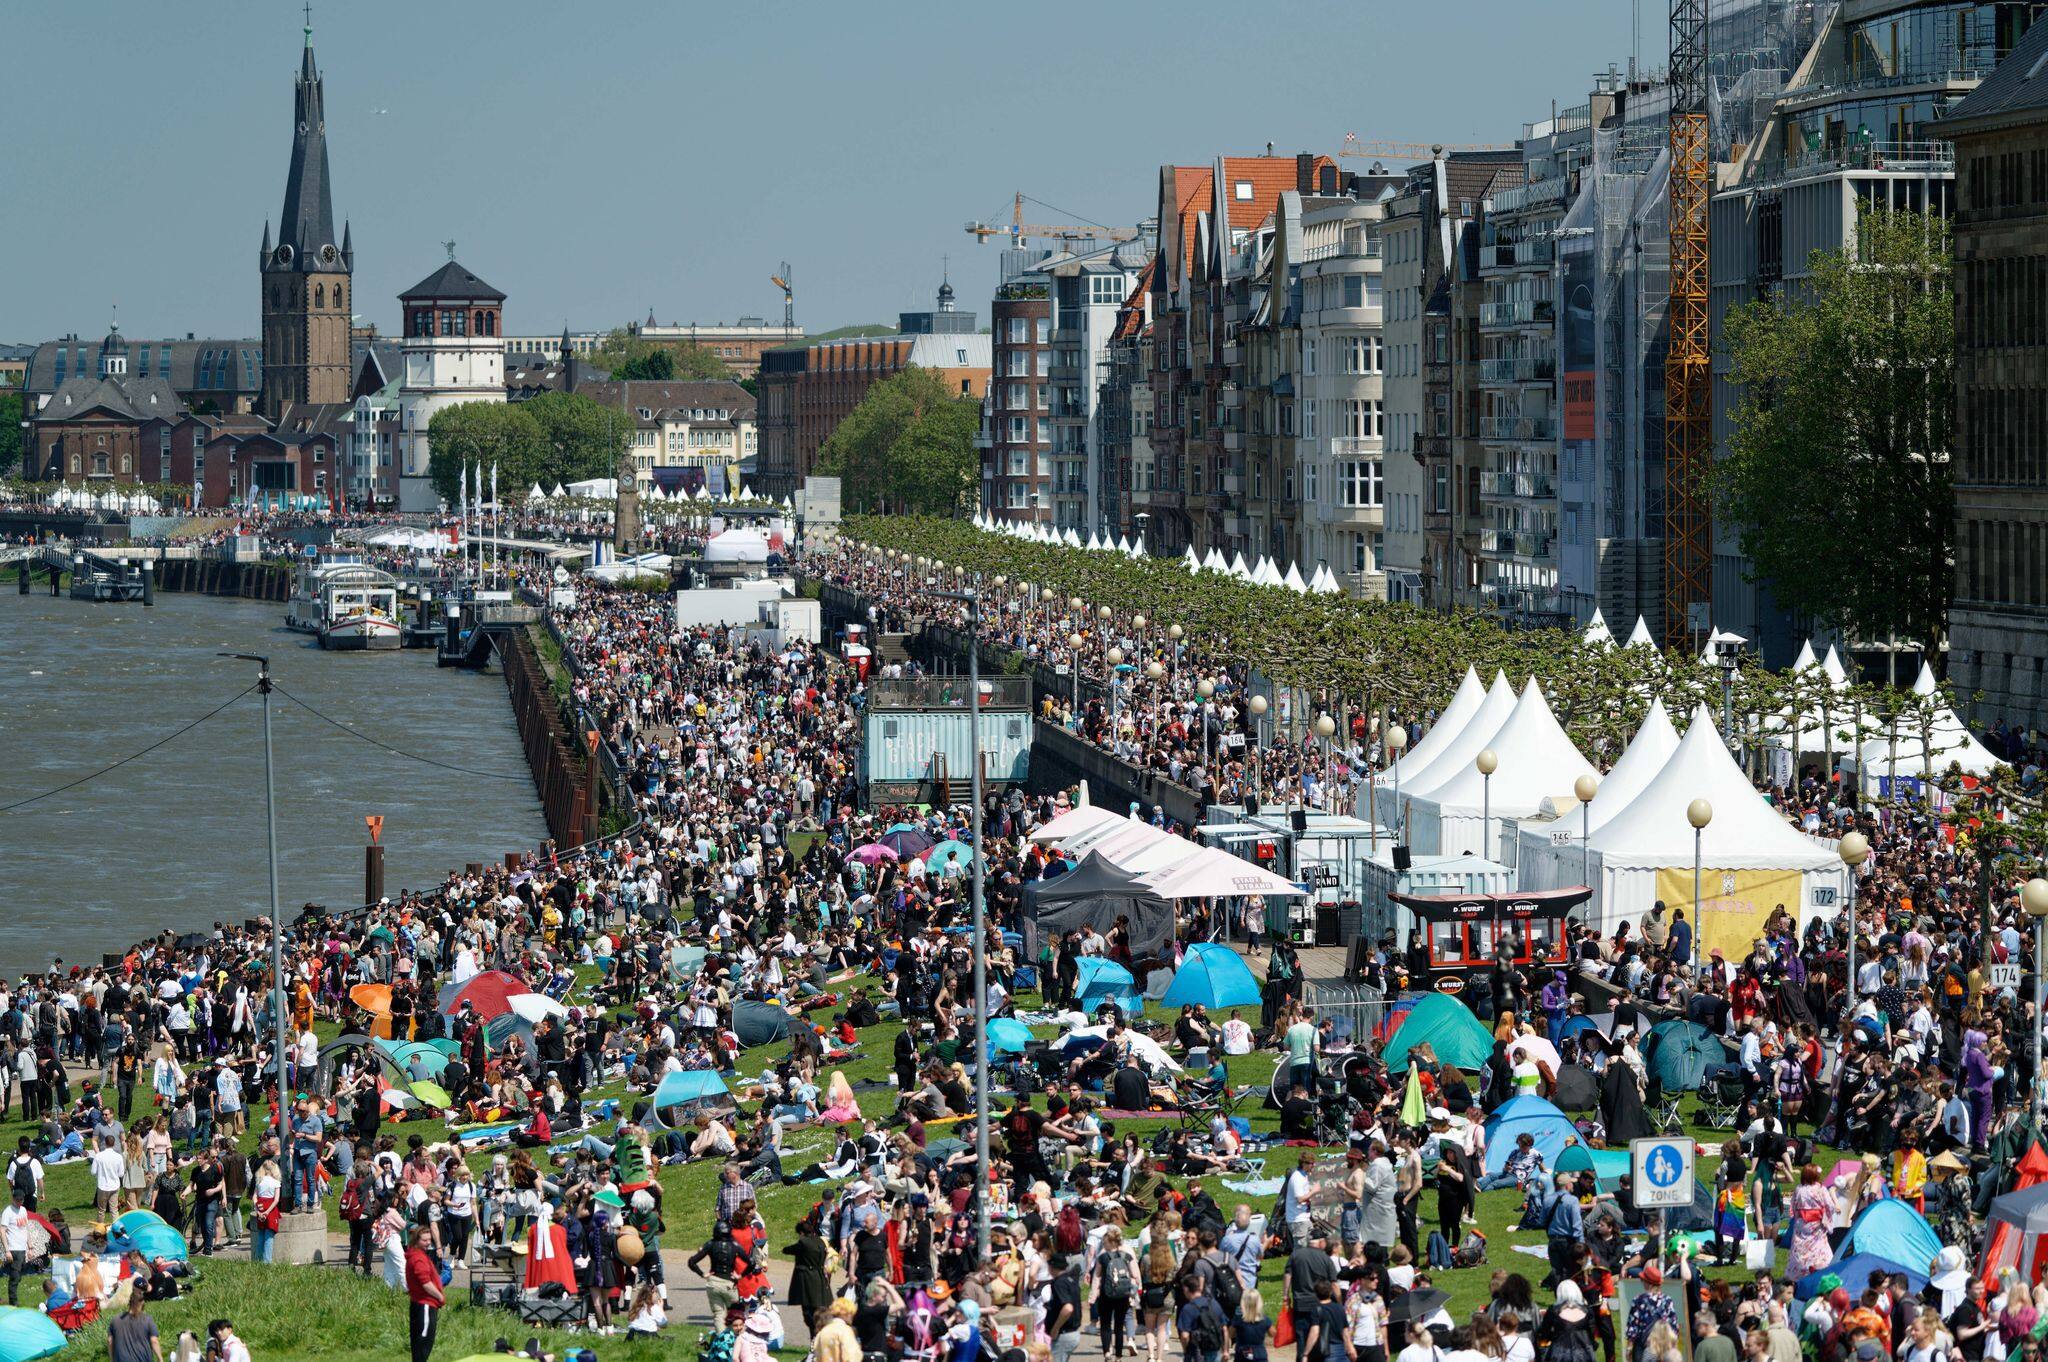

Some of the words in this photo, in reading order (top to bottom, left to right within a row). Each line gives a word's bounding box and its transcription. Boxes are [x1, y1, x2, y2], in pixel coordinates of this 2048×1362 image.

[1230, 735, 1244, 746] 164
[1306, 876, 1338, 887] SRAND
[1815, 890, 1834, 904] 172
[1994, 968, 2017, 983] 174
[1650, 1190, 1678, 1201] ZONE
